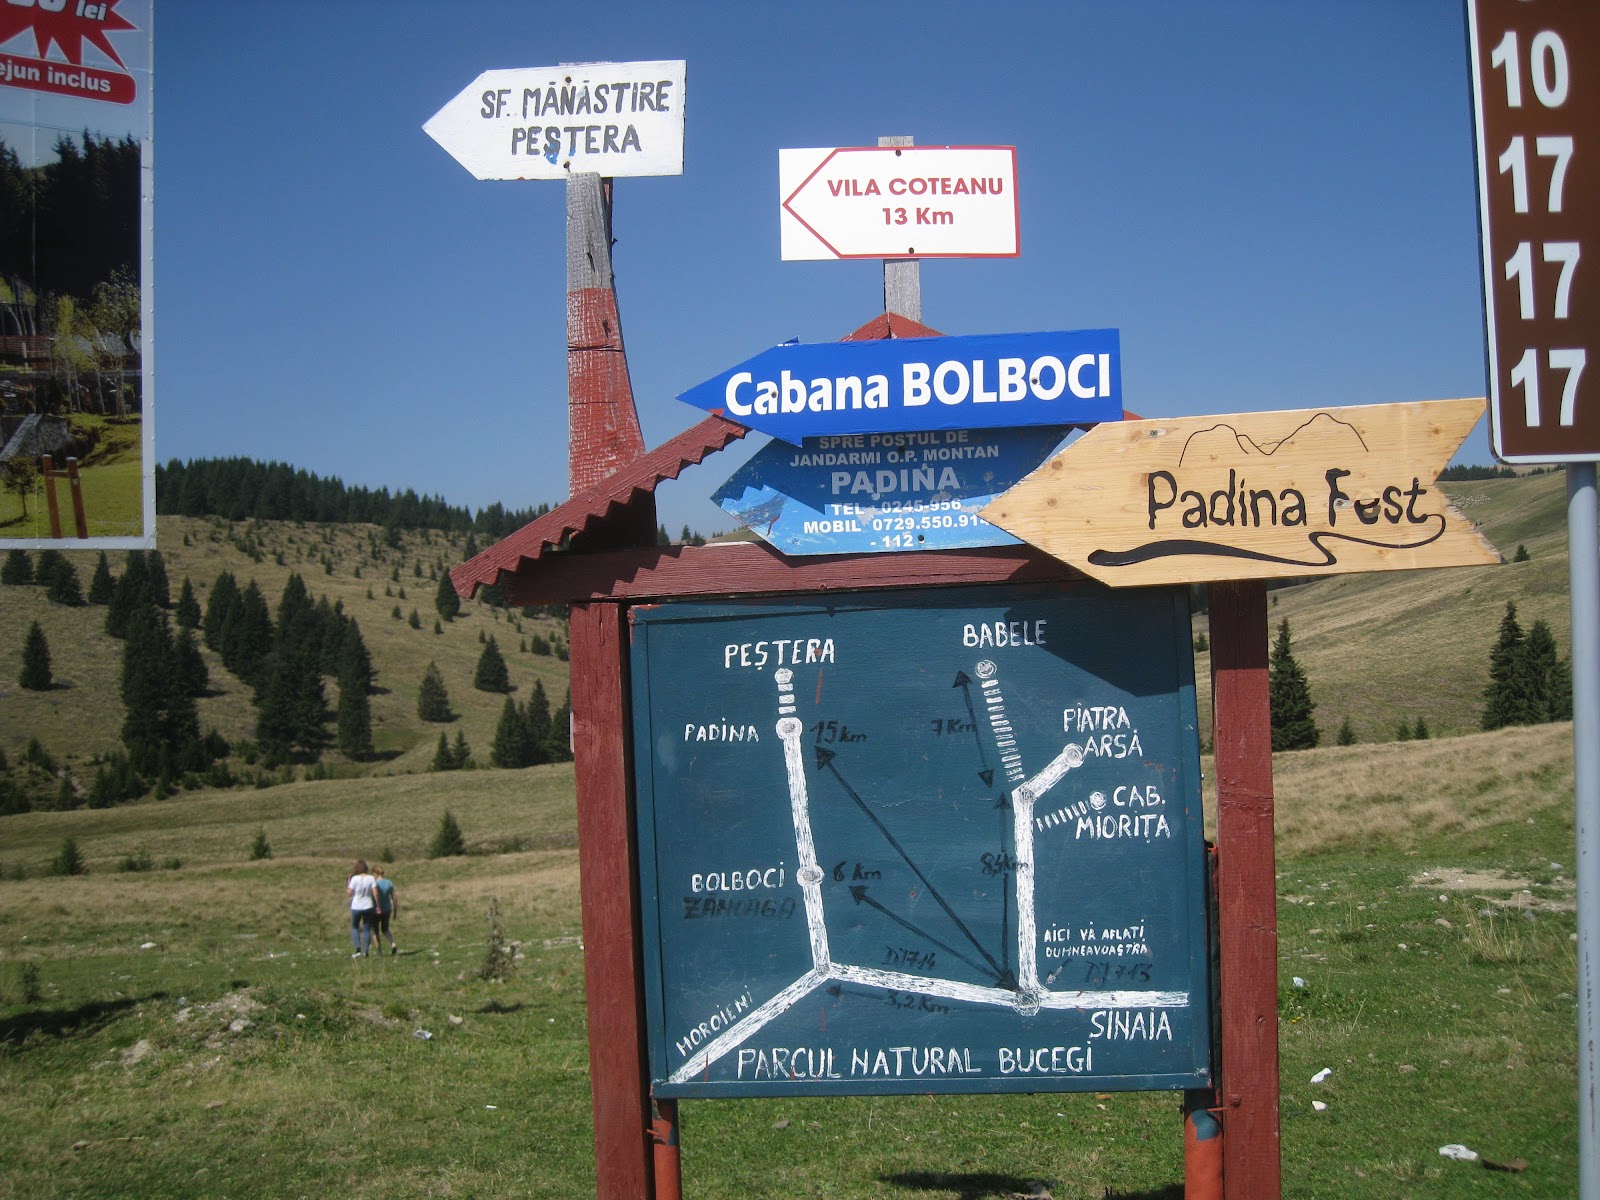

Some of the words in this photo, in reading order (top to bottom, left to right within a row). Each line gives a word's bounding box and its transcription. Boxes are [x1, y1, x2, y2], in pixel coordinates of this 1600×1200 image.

[76, 0, 107, 21] lei
[48, 66, 112, 93] inclus
[1491, 30, 1570, 109] 10
[480, 89, 511, 119] SF.
[827, 178, 881, 197] VILA
[888, 177, 1003, 196] COTEANU
[1498, 135, 1574, 213] 17
[882, 207, 908, 225] 13
[916, 207, 954, 225] Km
[1504, 241, 1581, 320] 17
[724, 369, 889, 417] Cabana
[902, 353, 1111, 407] BOLBOCI
[1510, 348, 1586, 427] 17
[819, 435, 865, 450] SPRE
[870, 431, 940, 447] POSTUL
[945, 430, 969, 444] DE
[789, 451, 881, 467] JANDARMI
[887, 450, 918, 463] O.P.
[923, 445, 999, 462] MONTAN
[831, 466, 961, 495] PADINA
[881, 498, 962, 514] 0245-956
[1147, 468, 1307, 529] Padina
[1324, 467, 1428, 527] Fest
[803, 519, 862, 534] MOBIL
[882, 534, 914, 549] 112
[962, 619, 1048, 649] BABELE
[684, 717, 760, 743] PADINA
[1063, 702, 1131, 733] PIATRA
[1112, 785, 1167, 808] CAB.
[691, 861, 785, 893] BOLBOCI
[675, 984, 753, 1057] MOROIENI
[1088, 1008, 1173, 1041] SINAIA
[737, 1047, 843, 1080] PARCUL
[850, 1046, 982, 1076] NATURAL
[998, 1040, 1092, 1075] BUCEGI
